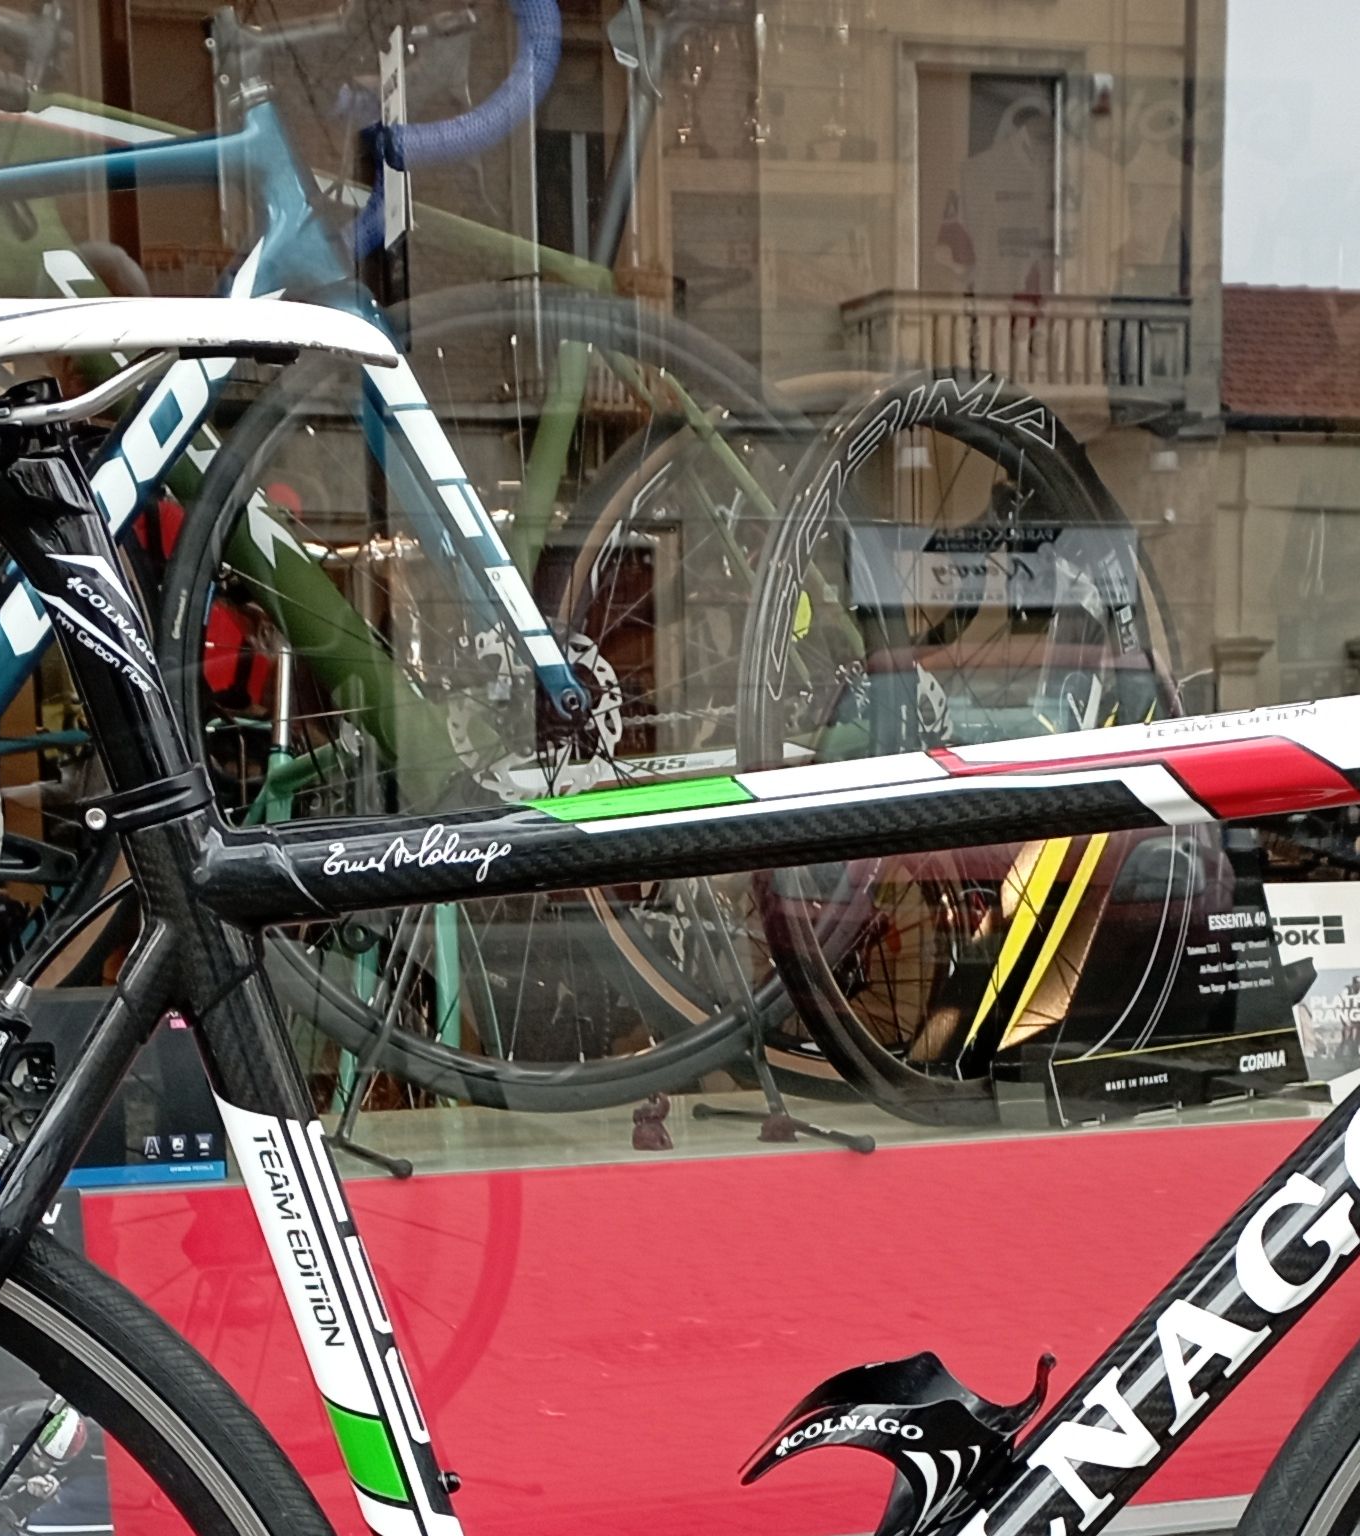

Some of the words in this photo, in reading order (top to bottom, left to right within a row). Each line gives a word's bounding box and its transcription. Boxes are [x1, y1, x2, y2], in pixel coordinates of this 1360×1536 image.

[76, 582, 156, 666] COLNAGO
[76, 629, 120, 668] Carbon
[1208, 912, 1254, 931] ESSENTIA
[1254, 911, 1268, 927] 40
[1274, 929, 1321, 946] OOK
[1239, 1050, 1287, 1074] CORIMA
[1105, 1080, 1127, 1092] MADE
[1128, 1078, 1138, 1089] IN
[1139, 1073, 1169, 1088] FRANCE
[252, 1128, 302, 1221] TEAM
[285, 1228, 346, 1347] EDITION
[787, 1413, 925, 1449] COLNAGO
